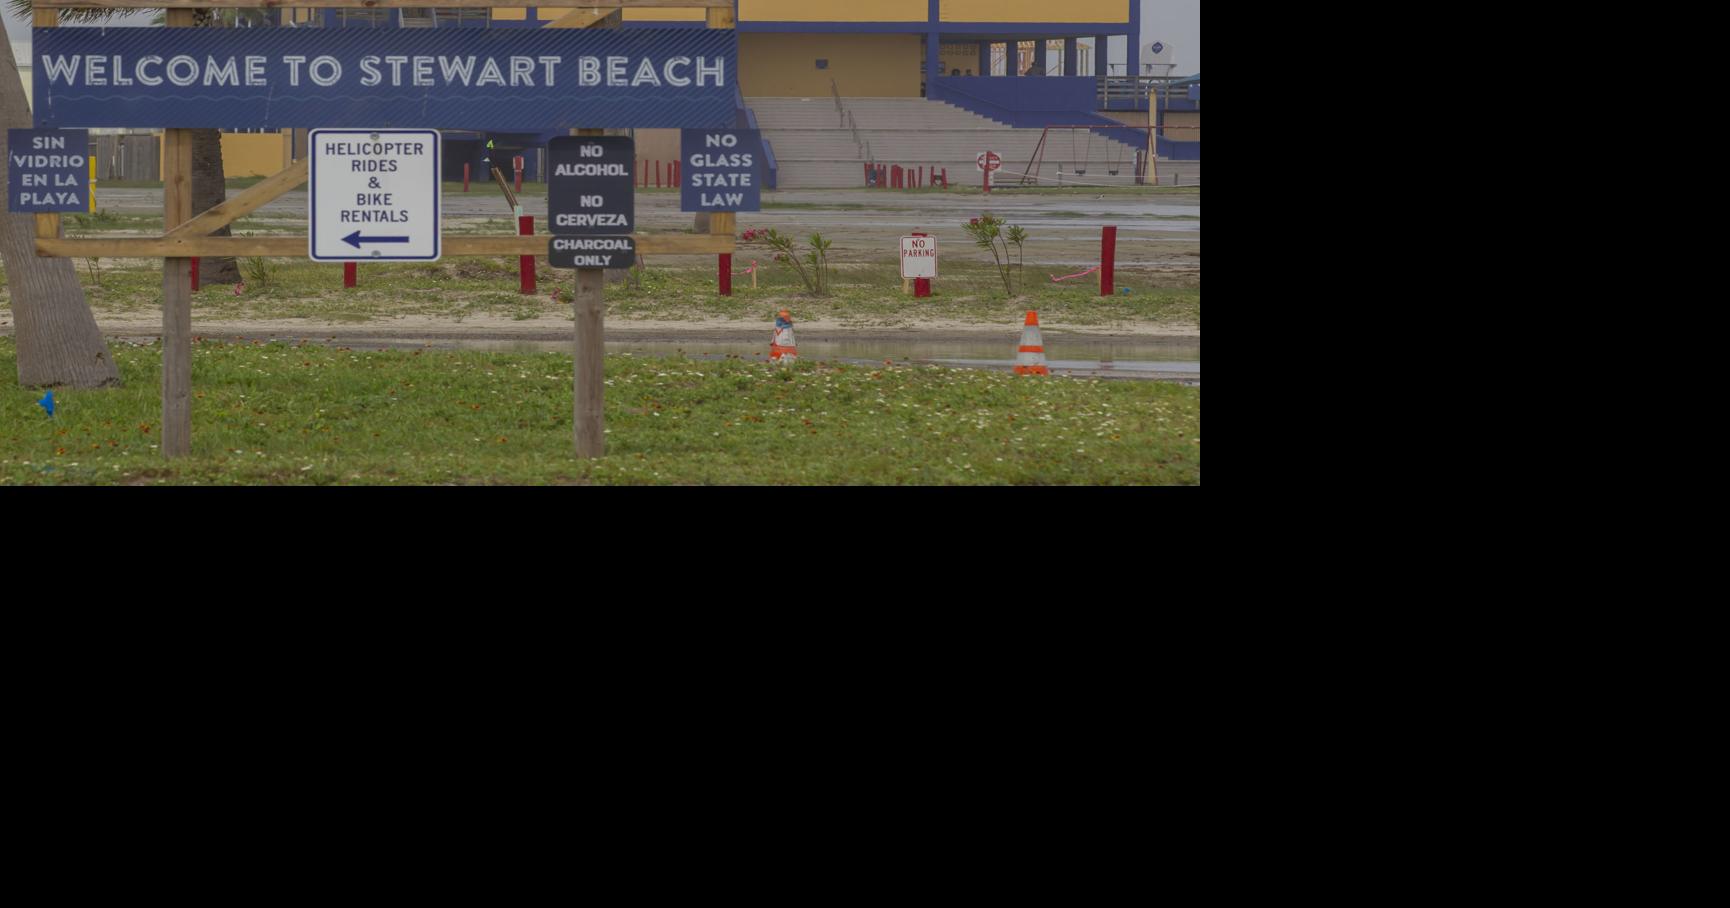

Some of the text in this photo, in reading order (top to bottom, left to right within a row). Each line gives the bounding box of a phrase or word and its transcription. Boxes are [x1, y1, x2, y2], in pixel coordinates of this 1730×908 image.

[42, 55, 725, 87] WELCOME TO STEWART BEACH
[32, 136, 65, 149] SIN
[705, 133, 738, 148] NO
[325, 142, 424, 155] HELICOPTER
[580, 145, 604, 158] NO
[13, 155, 84, 168] VIDRIO
[351, 160, 398, 172] RIDES
[690, 153, 753, 167] GLASS
[555, 163, 629, 176] ALCOHOL
[22, 173, 79, 187] EN LA
[368, 176, 381, 189] &
[691, 173, 752, 187] STATE
[20, 192, 81, 205] PLAYA
[356, 193, 393, 206] BIKE
[580, 195, 604, 208] NO
[701, 193, 744, 206] LAW
[341, 210, 409, 223] RENTALS
[556, 214, 629, 226] CERVEZA
[553, 239, 633, 250] CHARCOAL
[912, 239, 926, 249] NO
[903, 249, 935, 258] PARKING
[573, 255, 613, 266] ONLY
